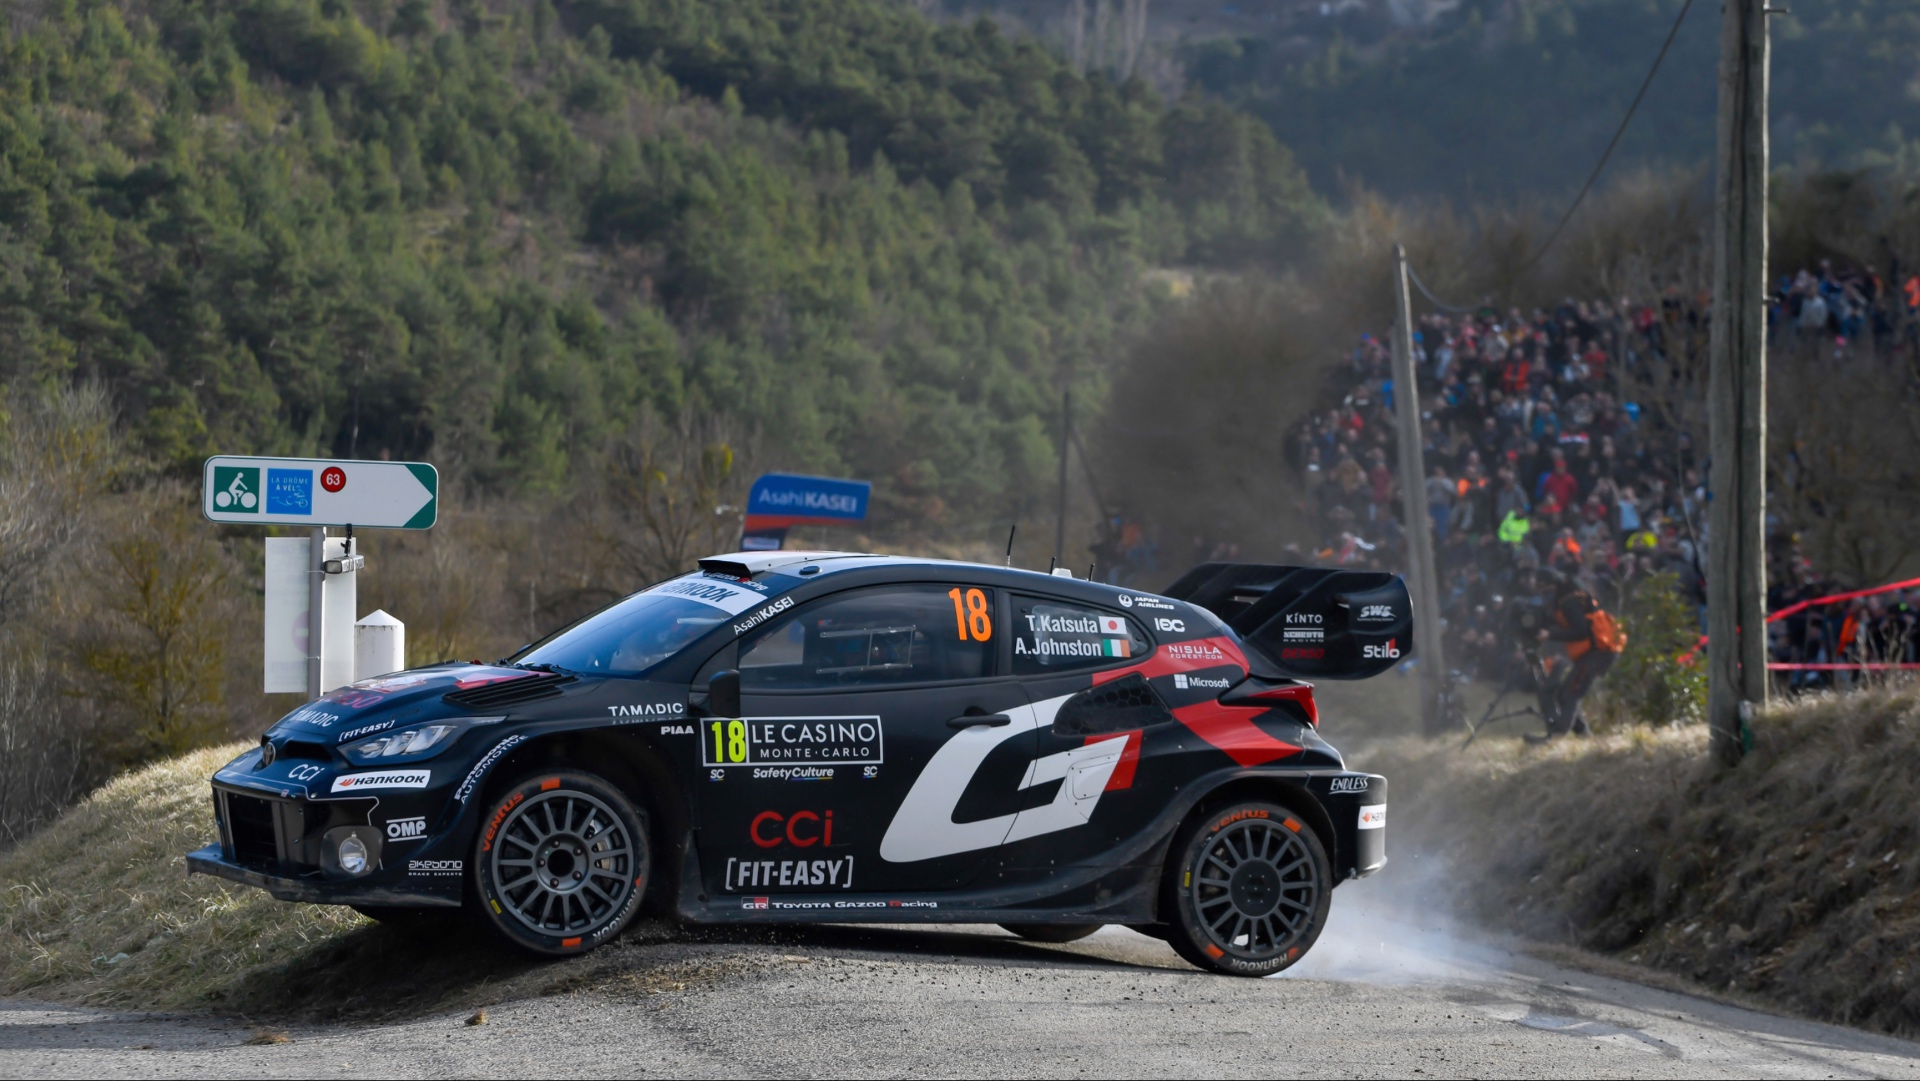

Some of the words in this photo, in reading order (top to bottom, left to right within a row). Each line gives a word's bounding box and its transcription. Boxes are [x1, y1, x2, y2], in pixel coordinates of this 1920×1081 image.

[326, 474, 340, 485] 63
[759, 488, 857, 513] AsahiKASEI
[1134, 596, 1160, 604] JAPAN
[1137, 602, 1175, 610] AIRLINES
[733, 595, 795, 635] AsahiKASEI
[948, 587, 993, 642] 18
[1360, 605, 1396, 618] SWS
[1025, 614, 1098, 634] T.Katsuta
[1015, 637, 1101, 657] A.Johnston
[1168, 645, 1222, 656] NISULA
[1363, 640, 1400, 658] Stilo
[1189, 676, 1230, 689] Microsoft
[608, 702, 684, 717] TAMADIC
[661, 725, 694, 735] PIAA
[752, 724, 775, 743] LE
[781, 723, 876, 743] CASINO
[711, 720, 746, 763] 18
[454, 734, 519, 801] Panasonic
[461, 735, 528, 805] AUTOMOTIVE
[710, 768, 725, 779] SC
[753, 767, 834, 780] SafetyCulture
[863, 766, 878, 777] SC
[1330, 777, 1369, 791] ENDLESS
[387, 820, 427, 838] OMP
[742, 902, 767, 910] GR
[889, 900, 938, 908] Racing
